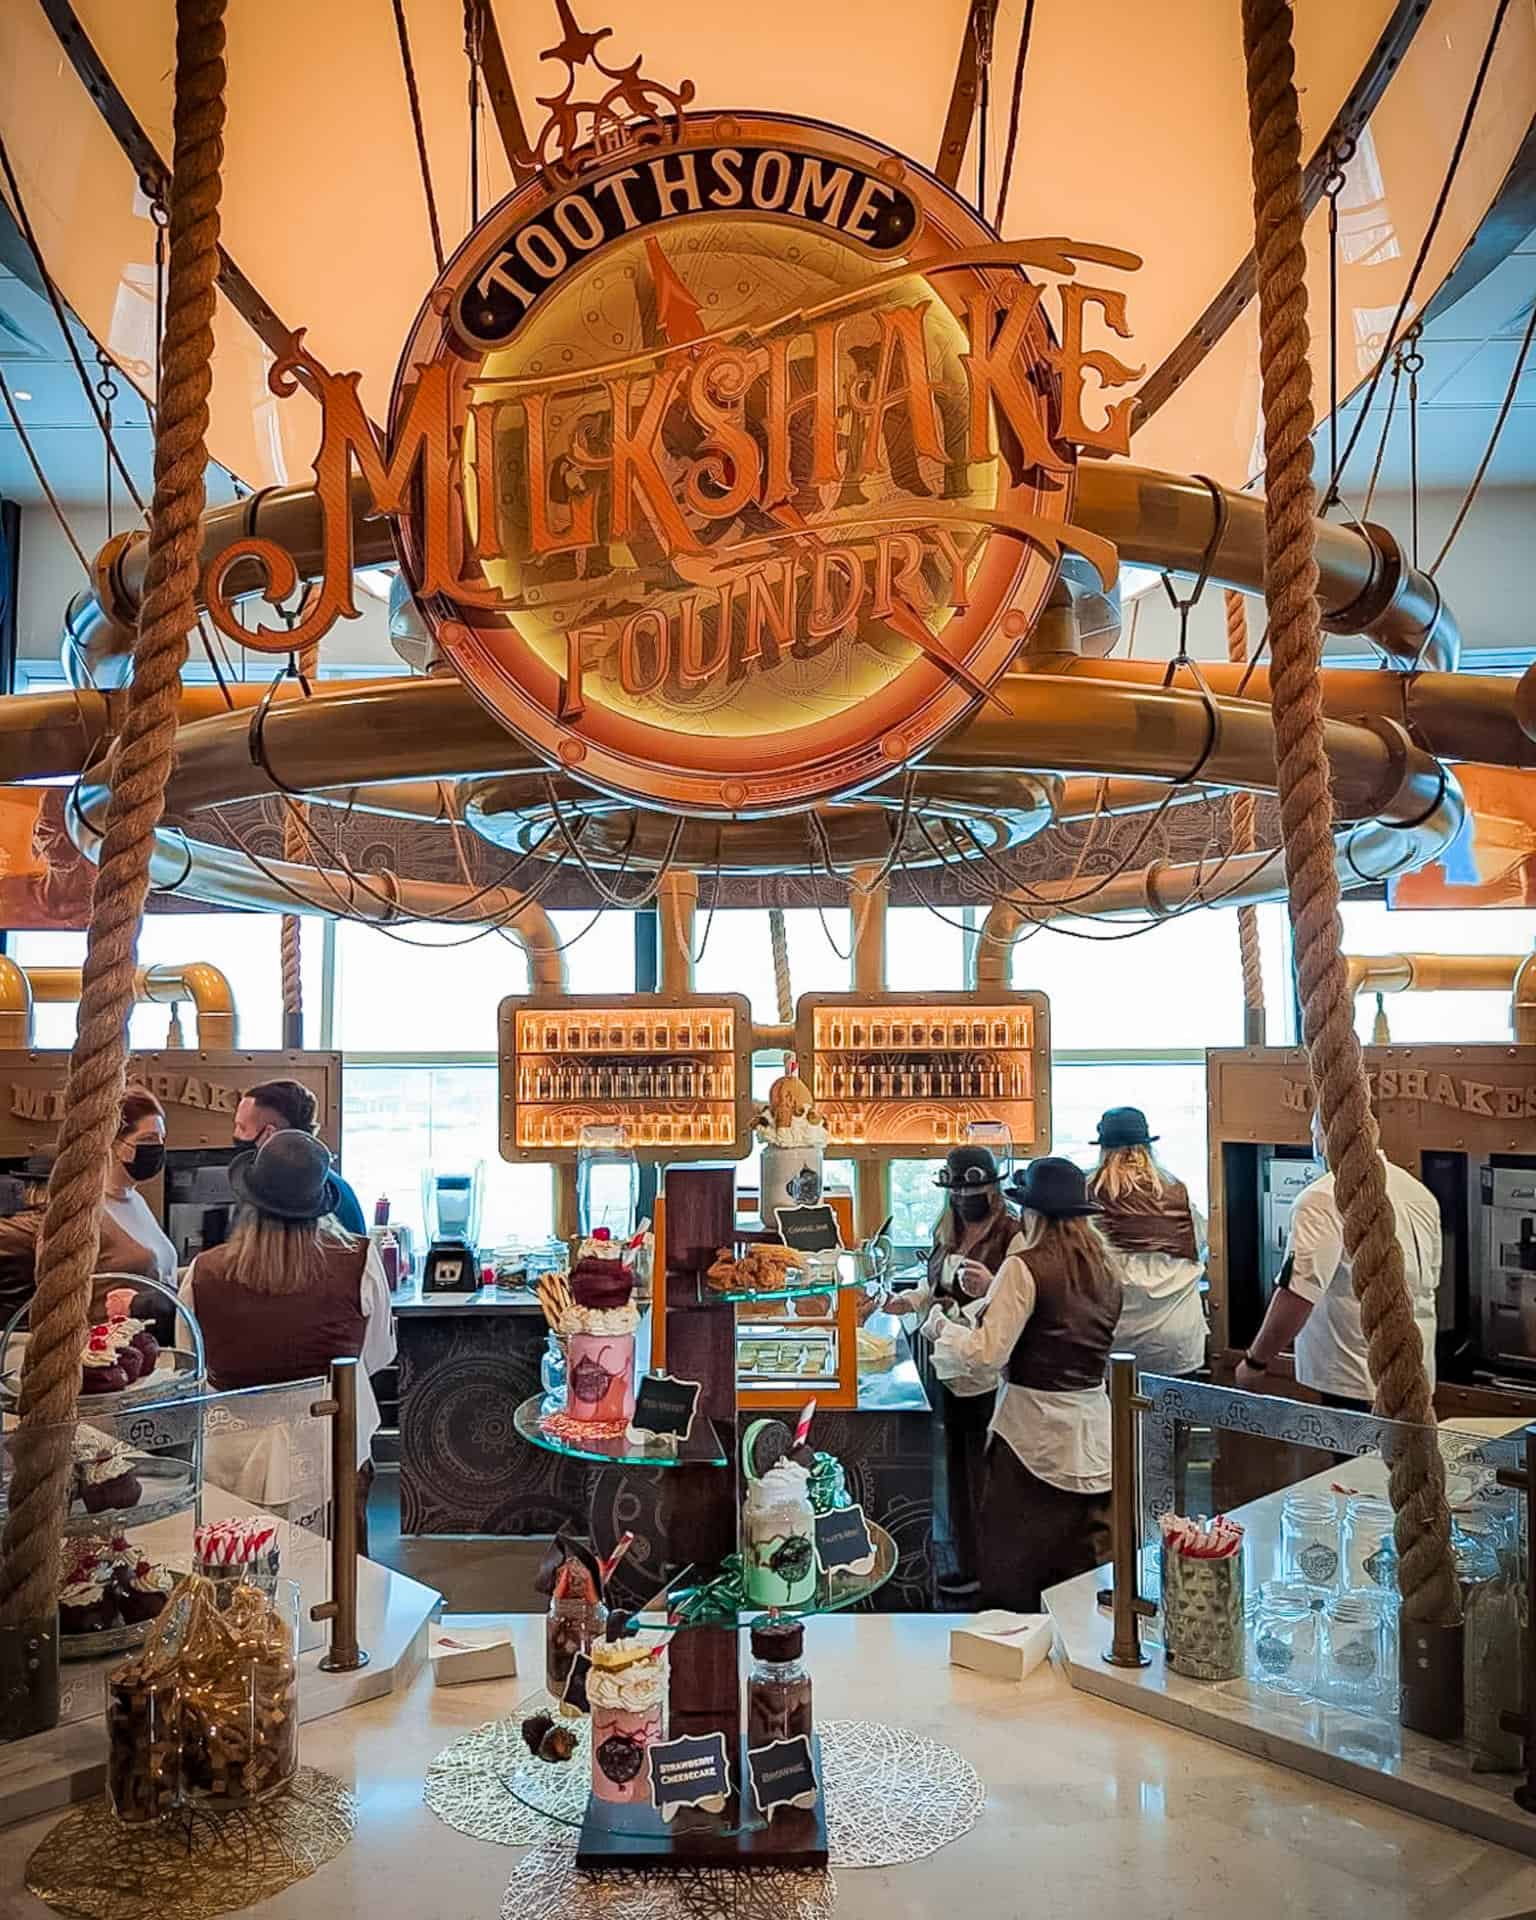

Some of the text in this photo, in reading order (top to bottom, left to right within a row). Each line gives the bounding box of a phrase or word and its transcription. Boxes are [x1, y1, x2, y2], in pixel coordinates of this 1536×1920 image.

[477, 145, 897, 306] TOOTHSOME
[204, 276, 1145, 655] MILKSHAKE
[558, 526, 1012, 721] FOUNDRY
